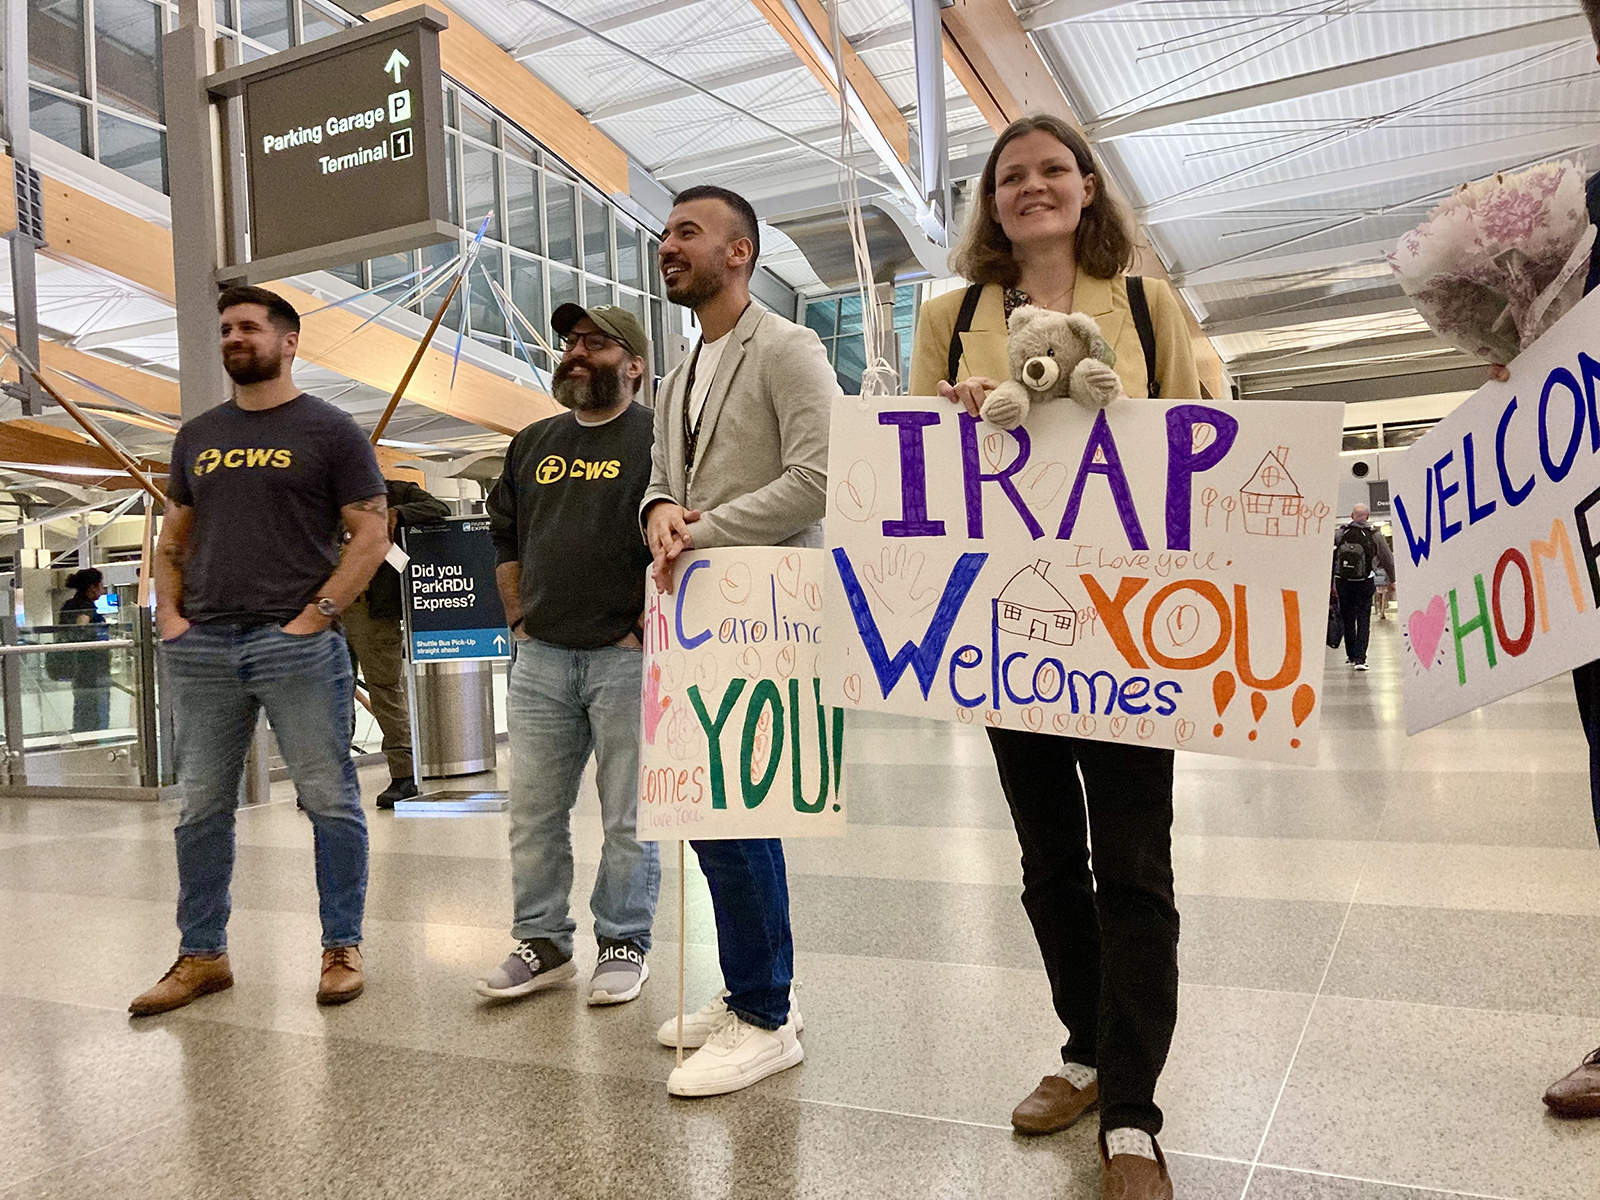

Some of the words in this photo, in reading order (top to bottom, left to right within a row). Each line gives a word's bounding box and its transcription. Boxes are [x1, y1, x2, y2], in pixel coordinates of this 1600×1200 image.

[263, 126, 323, 153] Parking
[326, 107, 385, 136] Garage
[319, 140, 388, 174] Terminal
[224, 448, 292, 468] CWS
[569, 458, 621, 481] CWS
[878, 404, 1239, 551] IRAP
[1065, 545, 1093, 568] I
[411, 564, 434, 578] Did
[438, 565, 462, 579] you
[412, 578, 474, 594] ParkRDU
[1449, 486, 1600, 686] HOME
[413, 594, 476, 612] Express?
[451, 638, 476, 646] Pick-Up
[832, 547, 1184, 717] Welcomes
[417, 647, 440, 655] straight
[641, 764, 705, 806] comes
